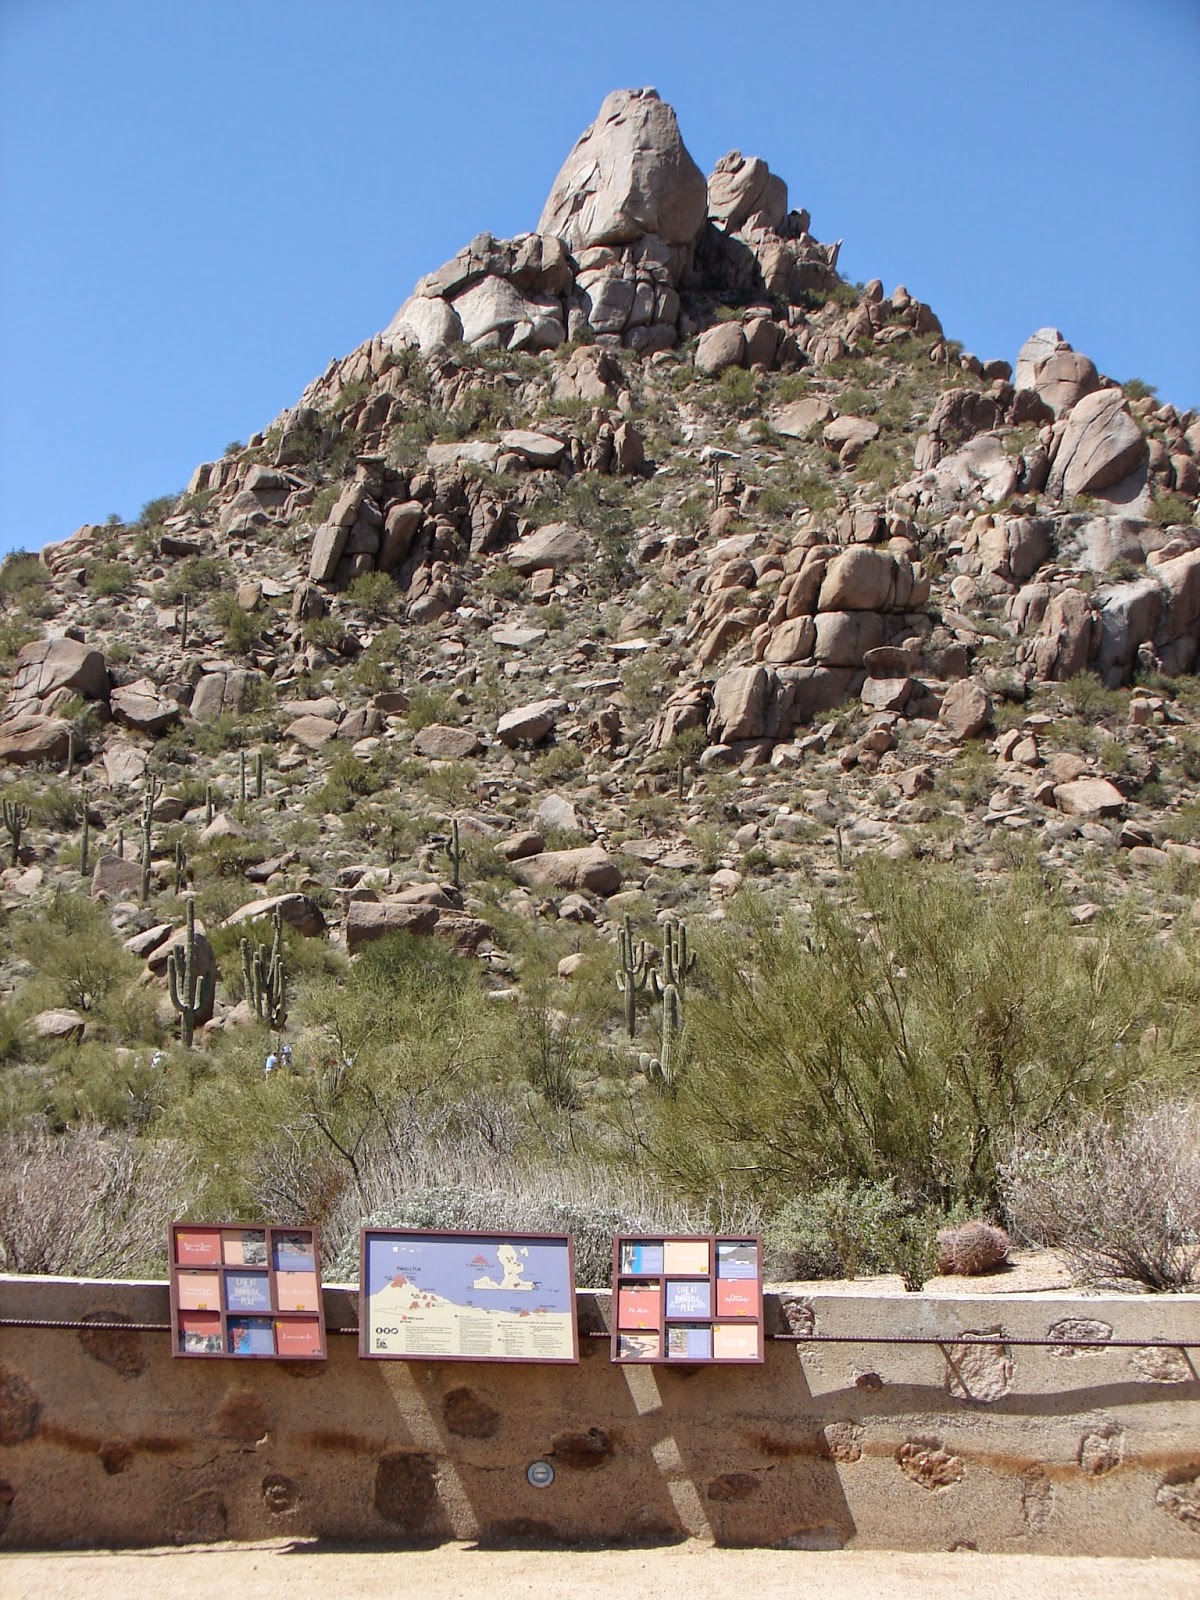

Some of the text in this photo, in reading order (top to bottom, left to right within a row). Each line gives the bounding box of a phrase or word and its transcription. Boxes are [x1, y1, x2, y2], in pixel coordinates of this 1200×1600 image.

[249, 1278, 257, 1286] AT
[677, 1286, 697, 1294] LIFE AT
[241, 1297, 255, 1306] PEAK
[680, 1304, 695, 1312] PEAK
